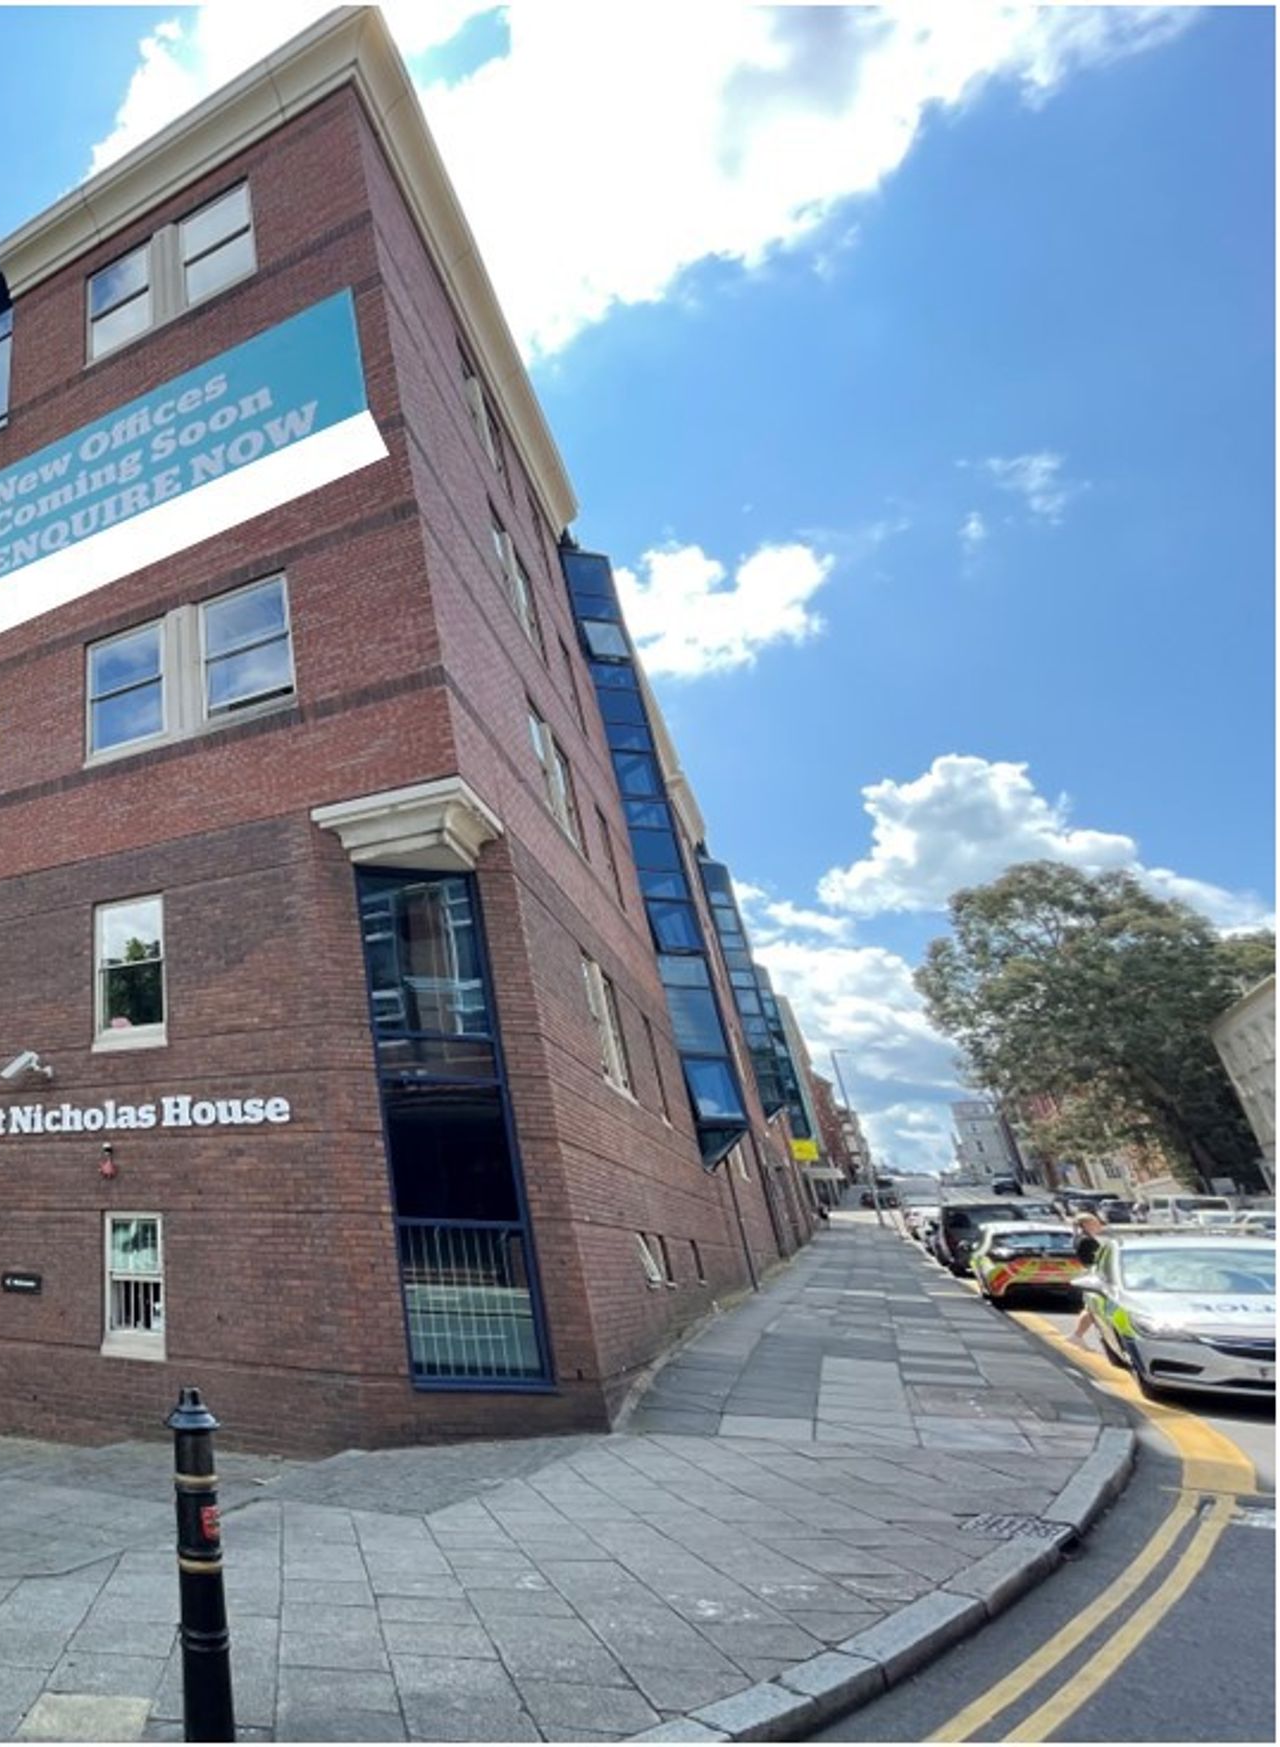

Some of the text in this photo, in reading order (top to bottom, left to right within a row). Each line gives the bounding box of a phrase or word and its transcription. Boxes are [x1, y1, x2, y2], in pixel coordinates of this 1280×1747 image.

[80, 374, 228, 458] Offices
[152, 388, 274, 462] Soon
[192, 402, 318, 485] NOW
[9, 1100, 157, 1135] Nicholas
[161, 1095, 291, 1128] House
